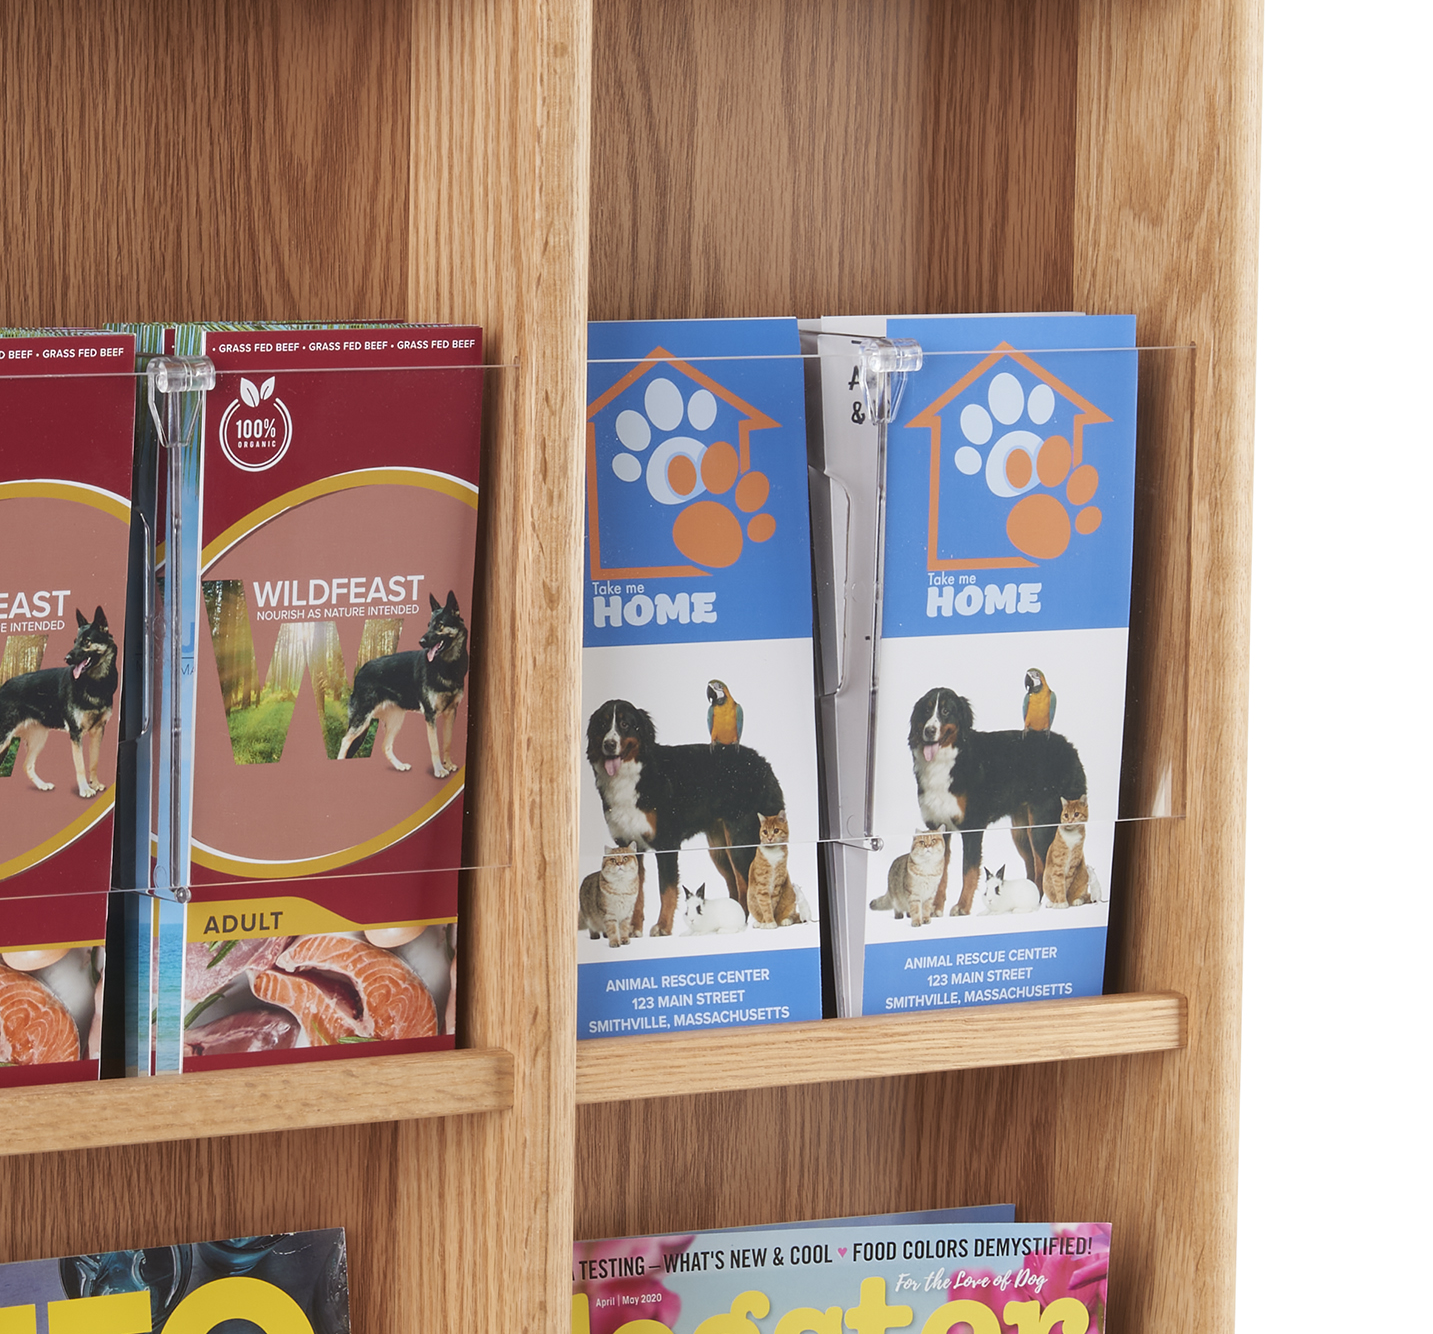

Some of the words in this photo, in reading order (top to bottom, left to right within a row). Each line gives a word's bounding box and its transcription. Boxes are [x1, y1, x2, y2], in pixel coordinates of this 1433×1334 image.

[253, 575, 424, 607] WILDFEAST
[926, 582, 1042, 618] HOME
[592, 592, 717, 628] HOME
[10, 620, 65, 632] INTENDED
[203, 912, 283, 934] ADULT
[904, 956, 953, 970] ANIMAL
[957, 951, 1005, 966] RESCUE
[1009, 947, 1057, 961] CENTER
[885, 992, 961, 1009] SMITHVILLE,
[964, 983, 1073, 1003] MASSACHUSETTS
[852, 1242, 897, 1262] FOOD
[902, 1239, 968, 1260] COLORS
[973, 1236, 1093, 1258] DEMYSTIFIED!
